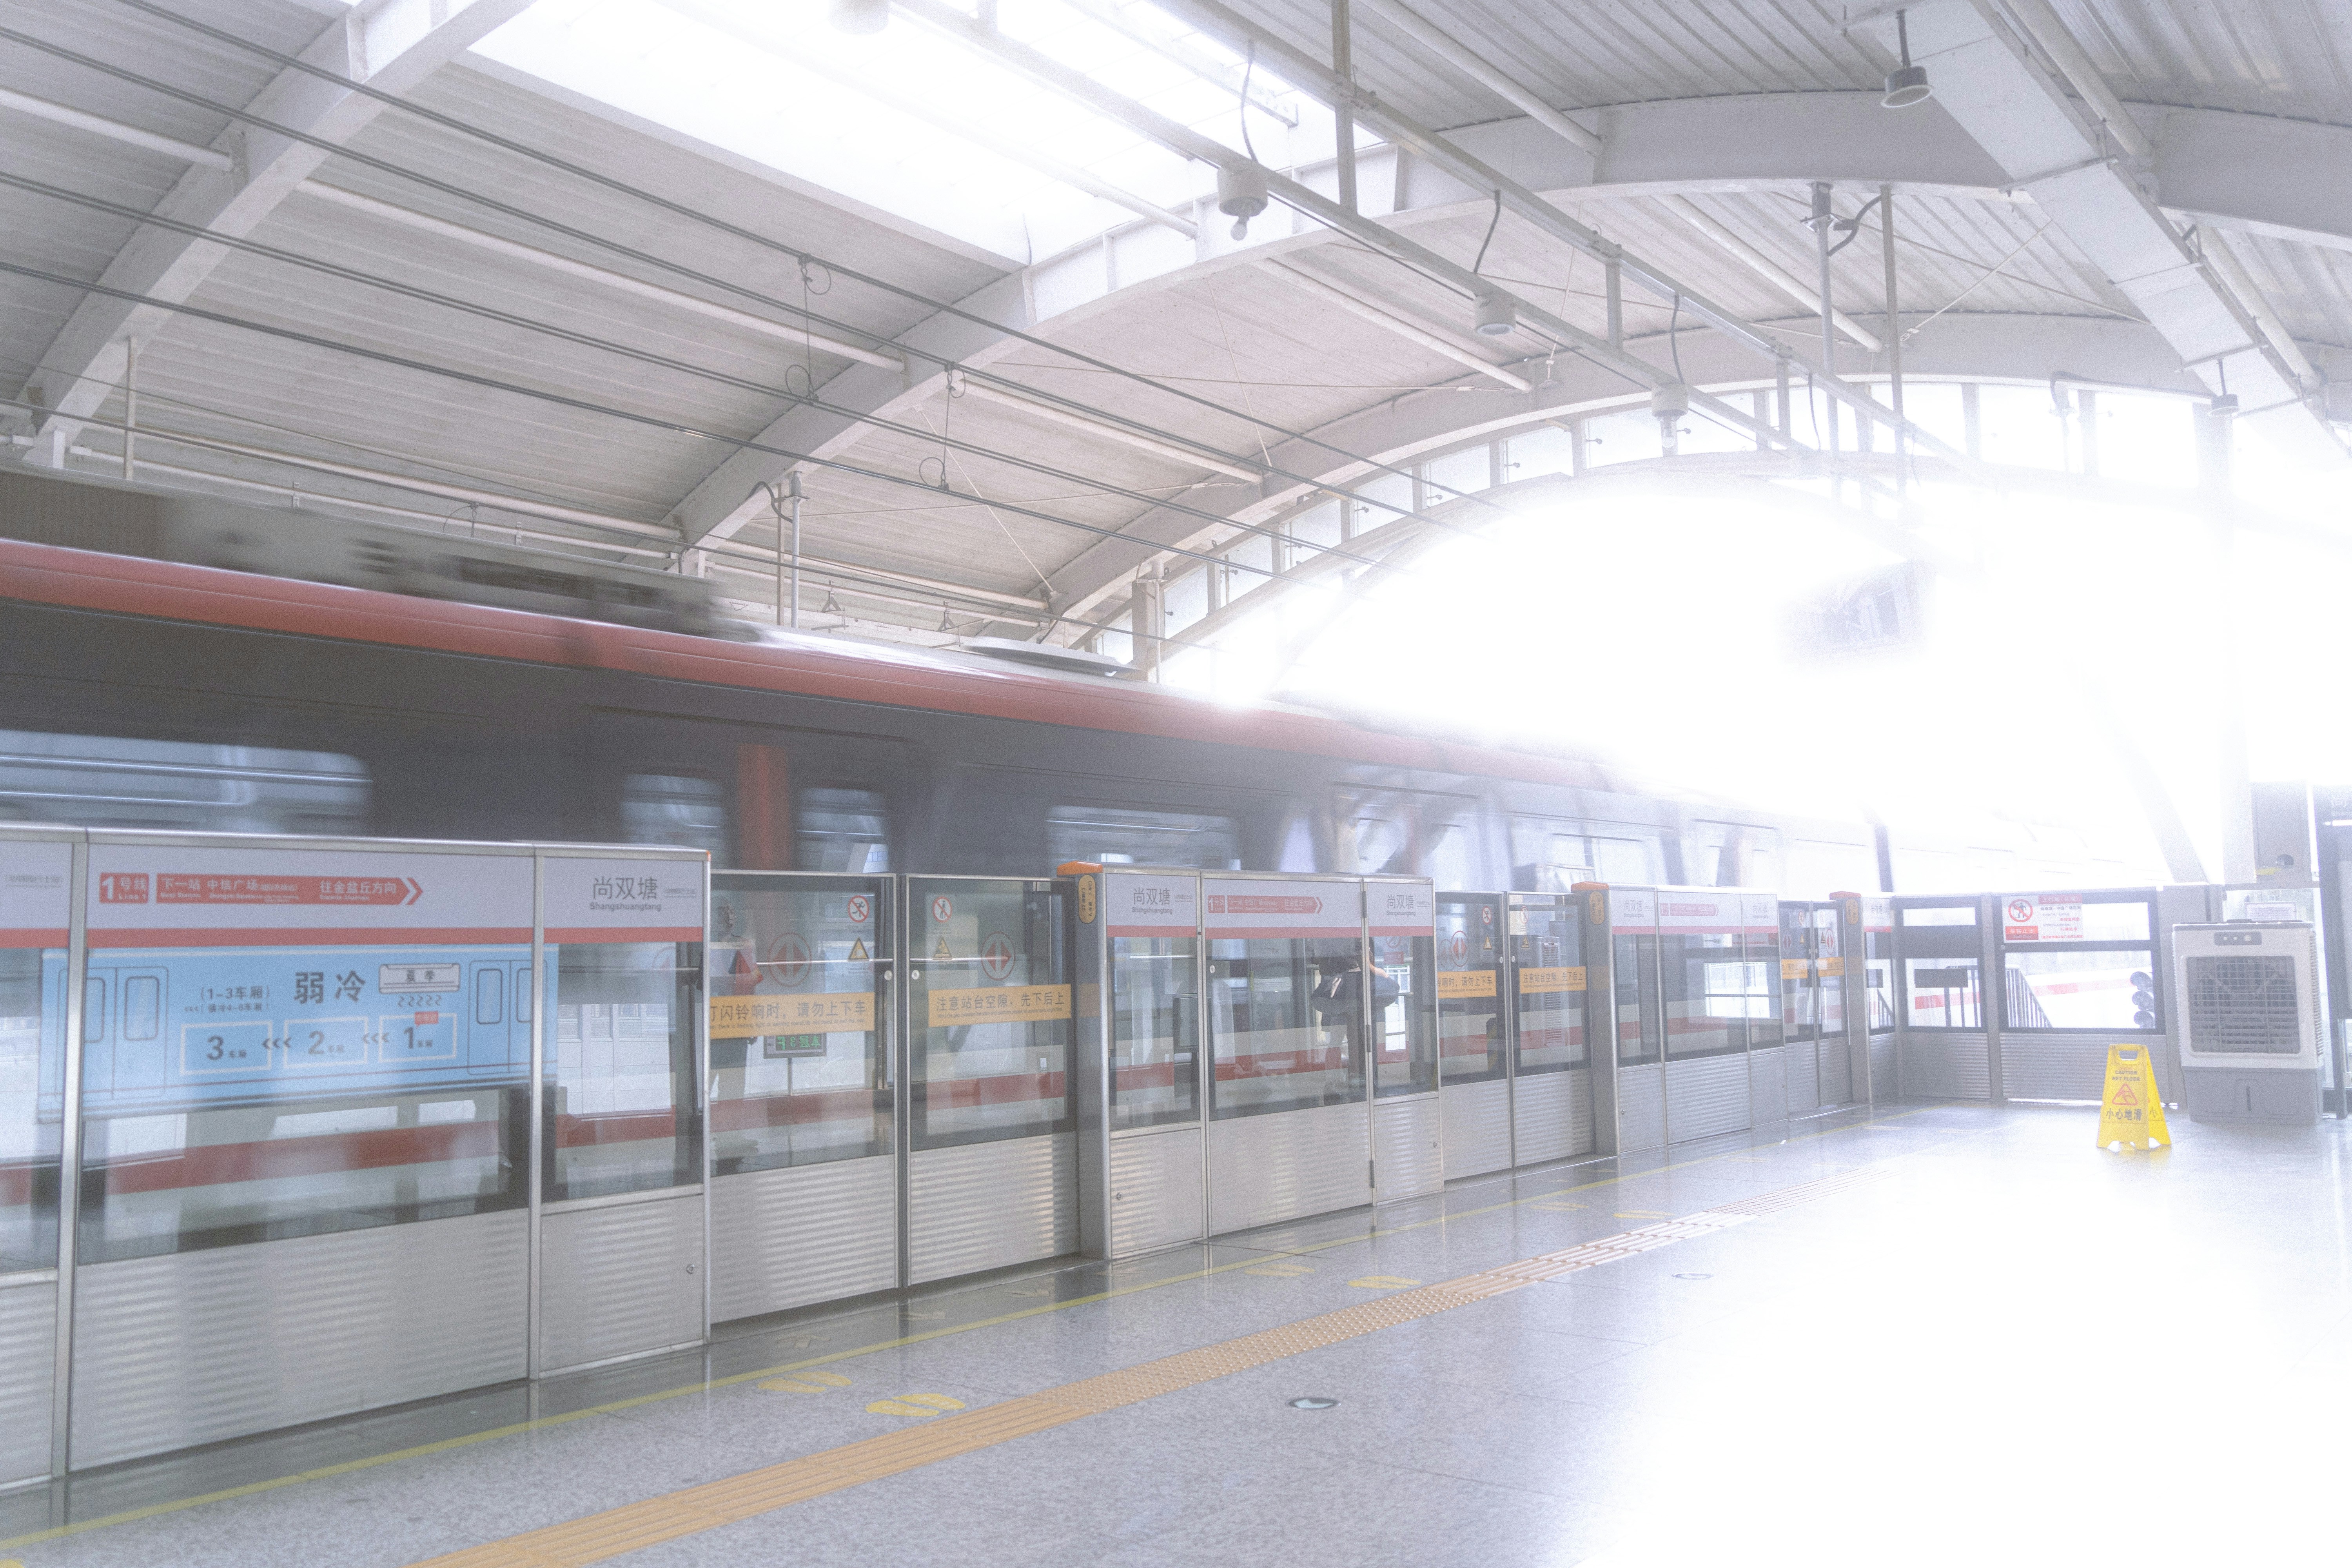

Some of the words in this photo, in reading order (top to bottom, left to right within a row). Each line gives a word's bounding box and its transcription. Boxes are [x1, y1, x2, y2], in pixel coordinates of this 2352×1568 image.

[161, 877, 201, 890] 下一站
[207, 878, 258, 891] 中信广场
[320, 880, 397, 895] 往金盆丘方向
[593, 876, 657, 900] 尚双塘
[1133, 887, 1171, 906] 尚双塘
[1387, 894, 1414, 909] 尚双塘
[590, 902, 662, 912] Shangshuangtang
[293, 970, 366, 1004] 弱冷
[2106, 1108, 2143, 1121] 小心地滑
